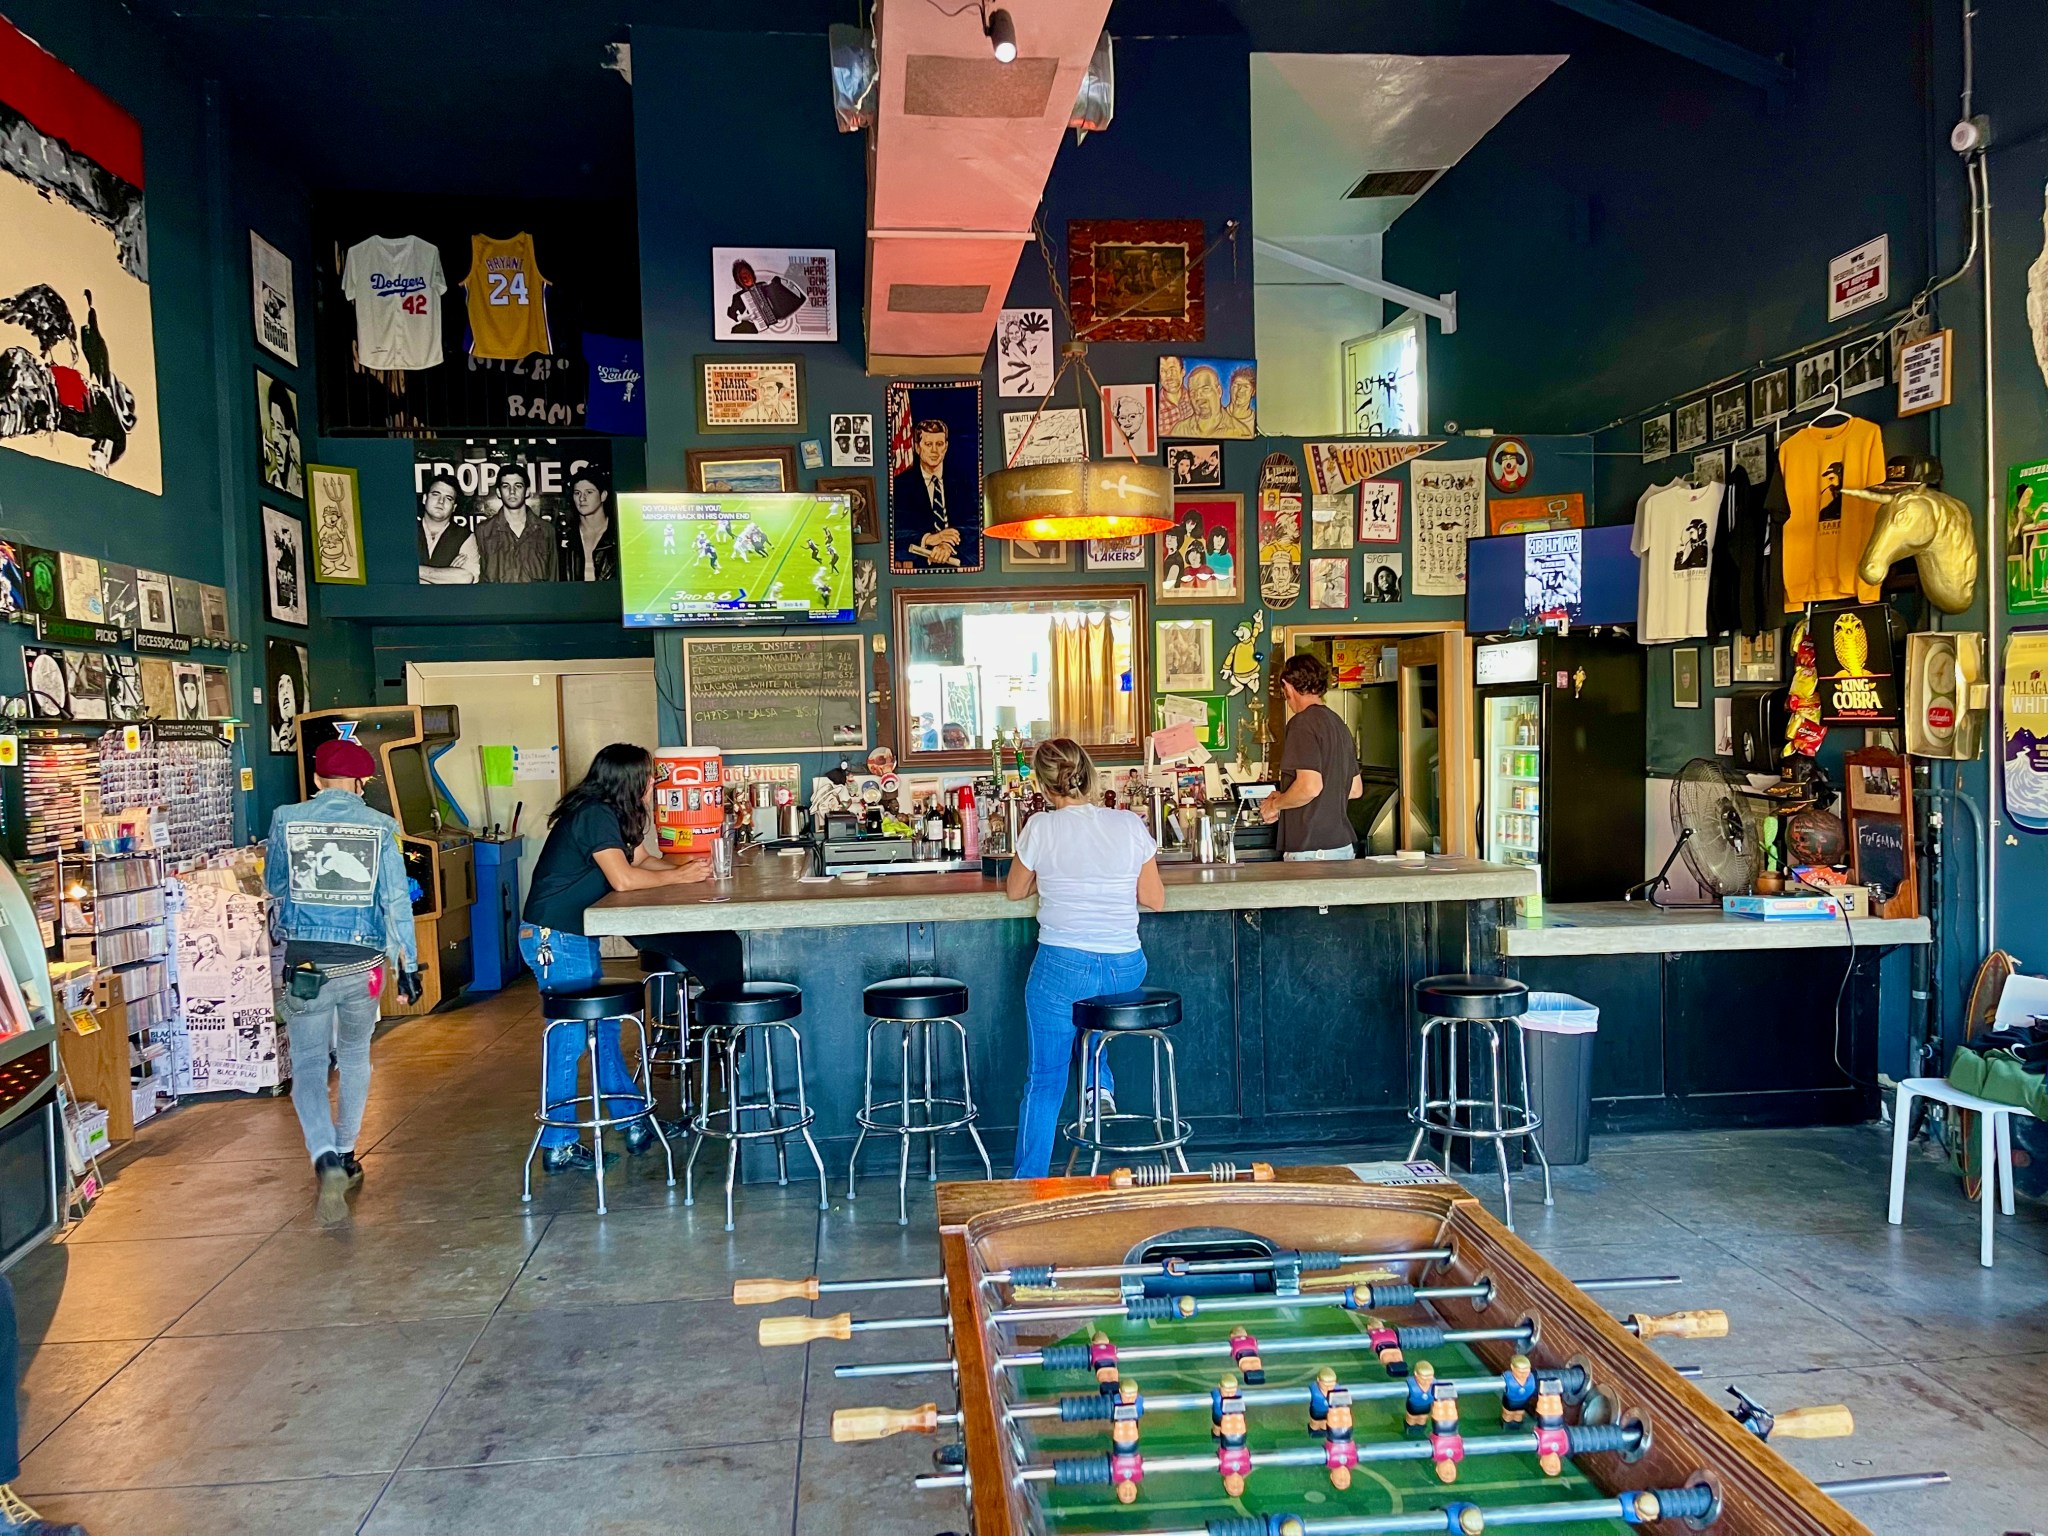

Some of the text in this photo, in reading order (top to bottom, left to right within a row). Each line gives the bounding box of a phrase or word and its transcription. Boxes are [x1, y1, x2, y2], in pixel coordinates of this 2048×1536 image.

[486, 256, 523, 271] BRYANT
[370, 273, 426, 297] Dodgers
[488, 272, 529, 306] 24
[402, 295, 427, 314] 42
[599, 366, 641, 382] Scully
[720, 378, 748, 389] HANK
[714, 389, 757, 401] WILLIAMS
[1009, 414, 1041, 423] MINUTEMN
[1337, 446, 1406, 485] WORTHY
[1093, 552, 1136, 562] LAKERS
[1366, 555, 1390, 564] SPOT
[671, 591, 732, 600] 3RD & 6
[95, 629, 118, 643] PICKS
[137, 633, 190, 651] RECESSOPS.COM
[692, 643, 726, 652] DRAFT
[731, 642, 756, 652] BEER
[1336, 653, 1344, 661] 50
[692, 666, 705, 675] EL
[708, 664, 750, 675] SEGUNDO
[694, 682, 738, 691] ALLAGASH
[750, 680, 777, 689] WHITE
[783, 680, 801, 689] ALE
[1841, 679, 1870, 692] KING
[2010, 680, 2048, 695] ALLAGA
[1832, 691, 1884, 709] COBRA
[2010, 696, 2048, 714] WHIT
[695, 709, 729, 722] CHIPS
[736, 709, 744, 718] N
[748, 708, 778, 720] SALSA
[288, 826, 380, 836] NEGATIVE APPROACH
[241, 1007, 272, 1016] BLACK
[241, 1016, 265, 1026] FLAG
[151, 1030, 178, 1038] BLACK
[193, 1060, 210, 1068] BLA
[193, 1068, 210, 1076] FLA
[240, 1070, 257, 1078] FLAG
